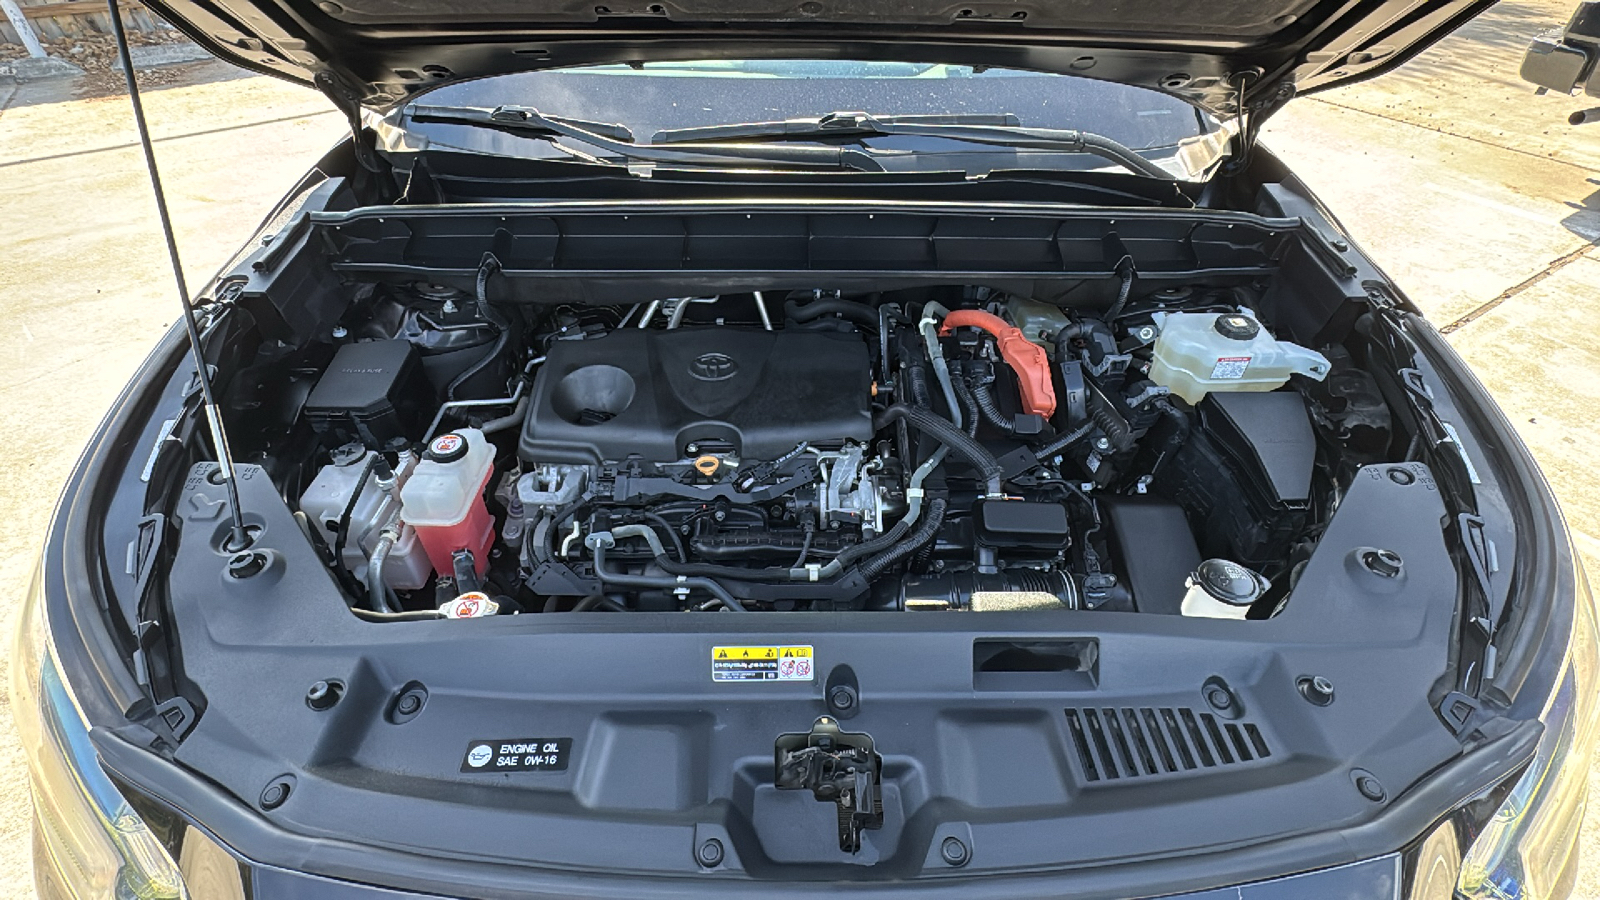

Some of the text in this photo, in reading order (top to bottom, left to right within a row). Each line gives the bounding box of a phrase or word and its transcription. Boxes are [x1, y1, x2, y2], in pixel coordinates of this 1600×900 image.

[500, 743, 559, 754] ENGINE OIL
[496, 755, 557, 766] SAE 0W-16
